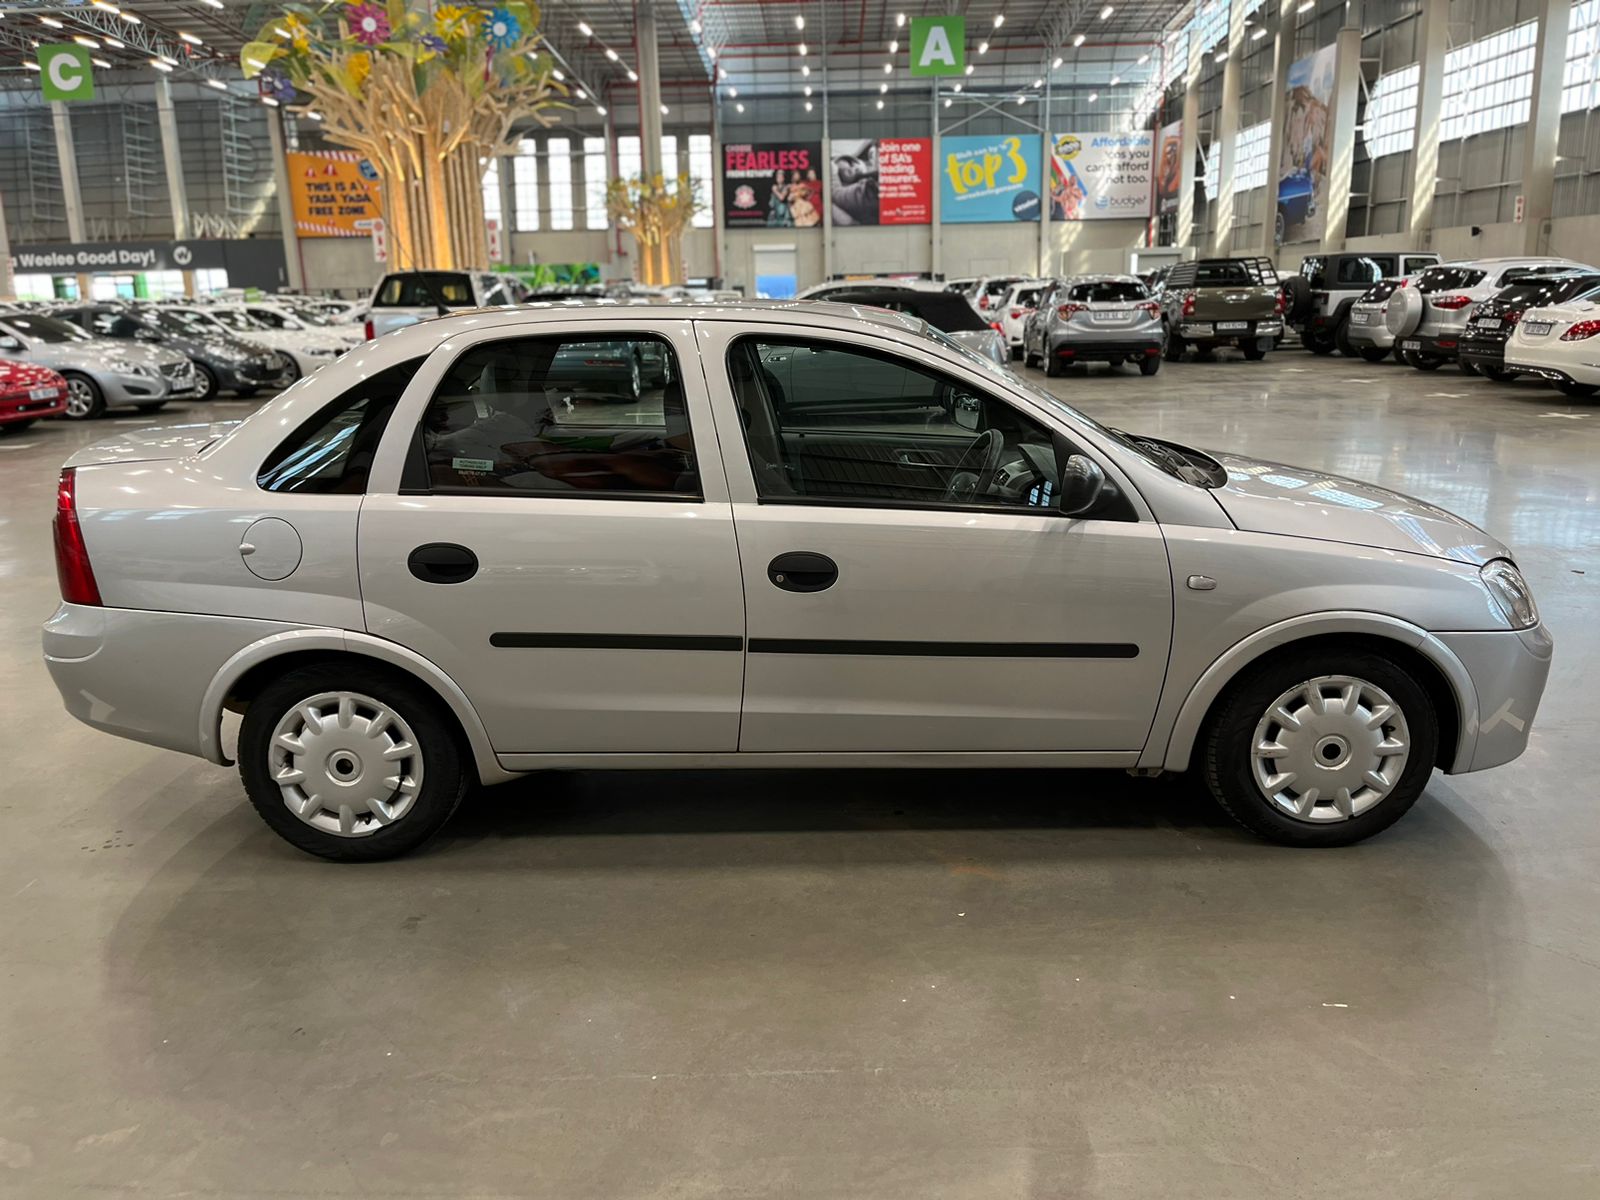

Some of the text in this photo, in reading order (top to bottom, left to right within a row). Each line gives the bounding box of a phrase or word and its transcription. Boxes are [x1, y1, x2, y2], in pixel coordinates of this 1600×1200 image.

[918, 26, 956, 66] A
[49, 53, 82, 91] C
[879, 142, 922, 153] Join one
[726, 150, 810, 171] FEARLESS
[879, 154, 890, 164] of
[1129, 150, 1150, 160] you
[944, 136, 1027, 194] top 3
[1127, 174, 1148, 183] too.
[306, 182, 332, 191] THIS
[335, 182, 346, 191] IS
[308, 206, 365, 215] FREE ZONE
[19, 253, 73, 267] Weelee
[77, 250, 117, 265] Good
[119, 249, 156, 267] Day!
